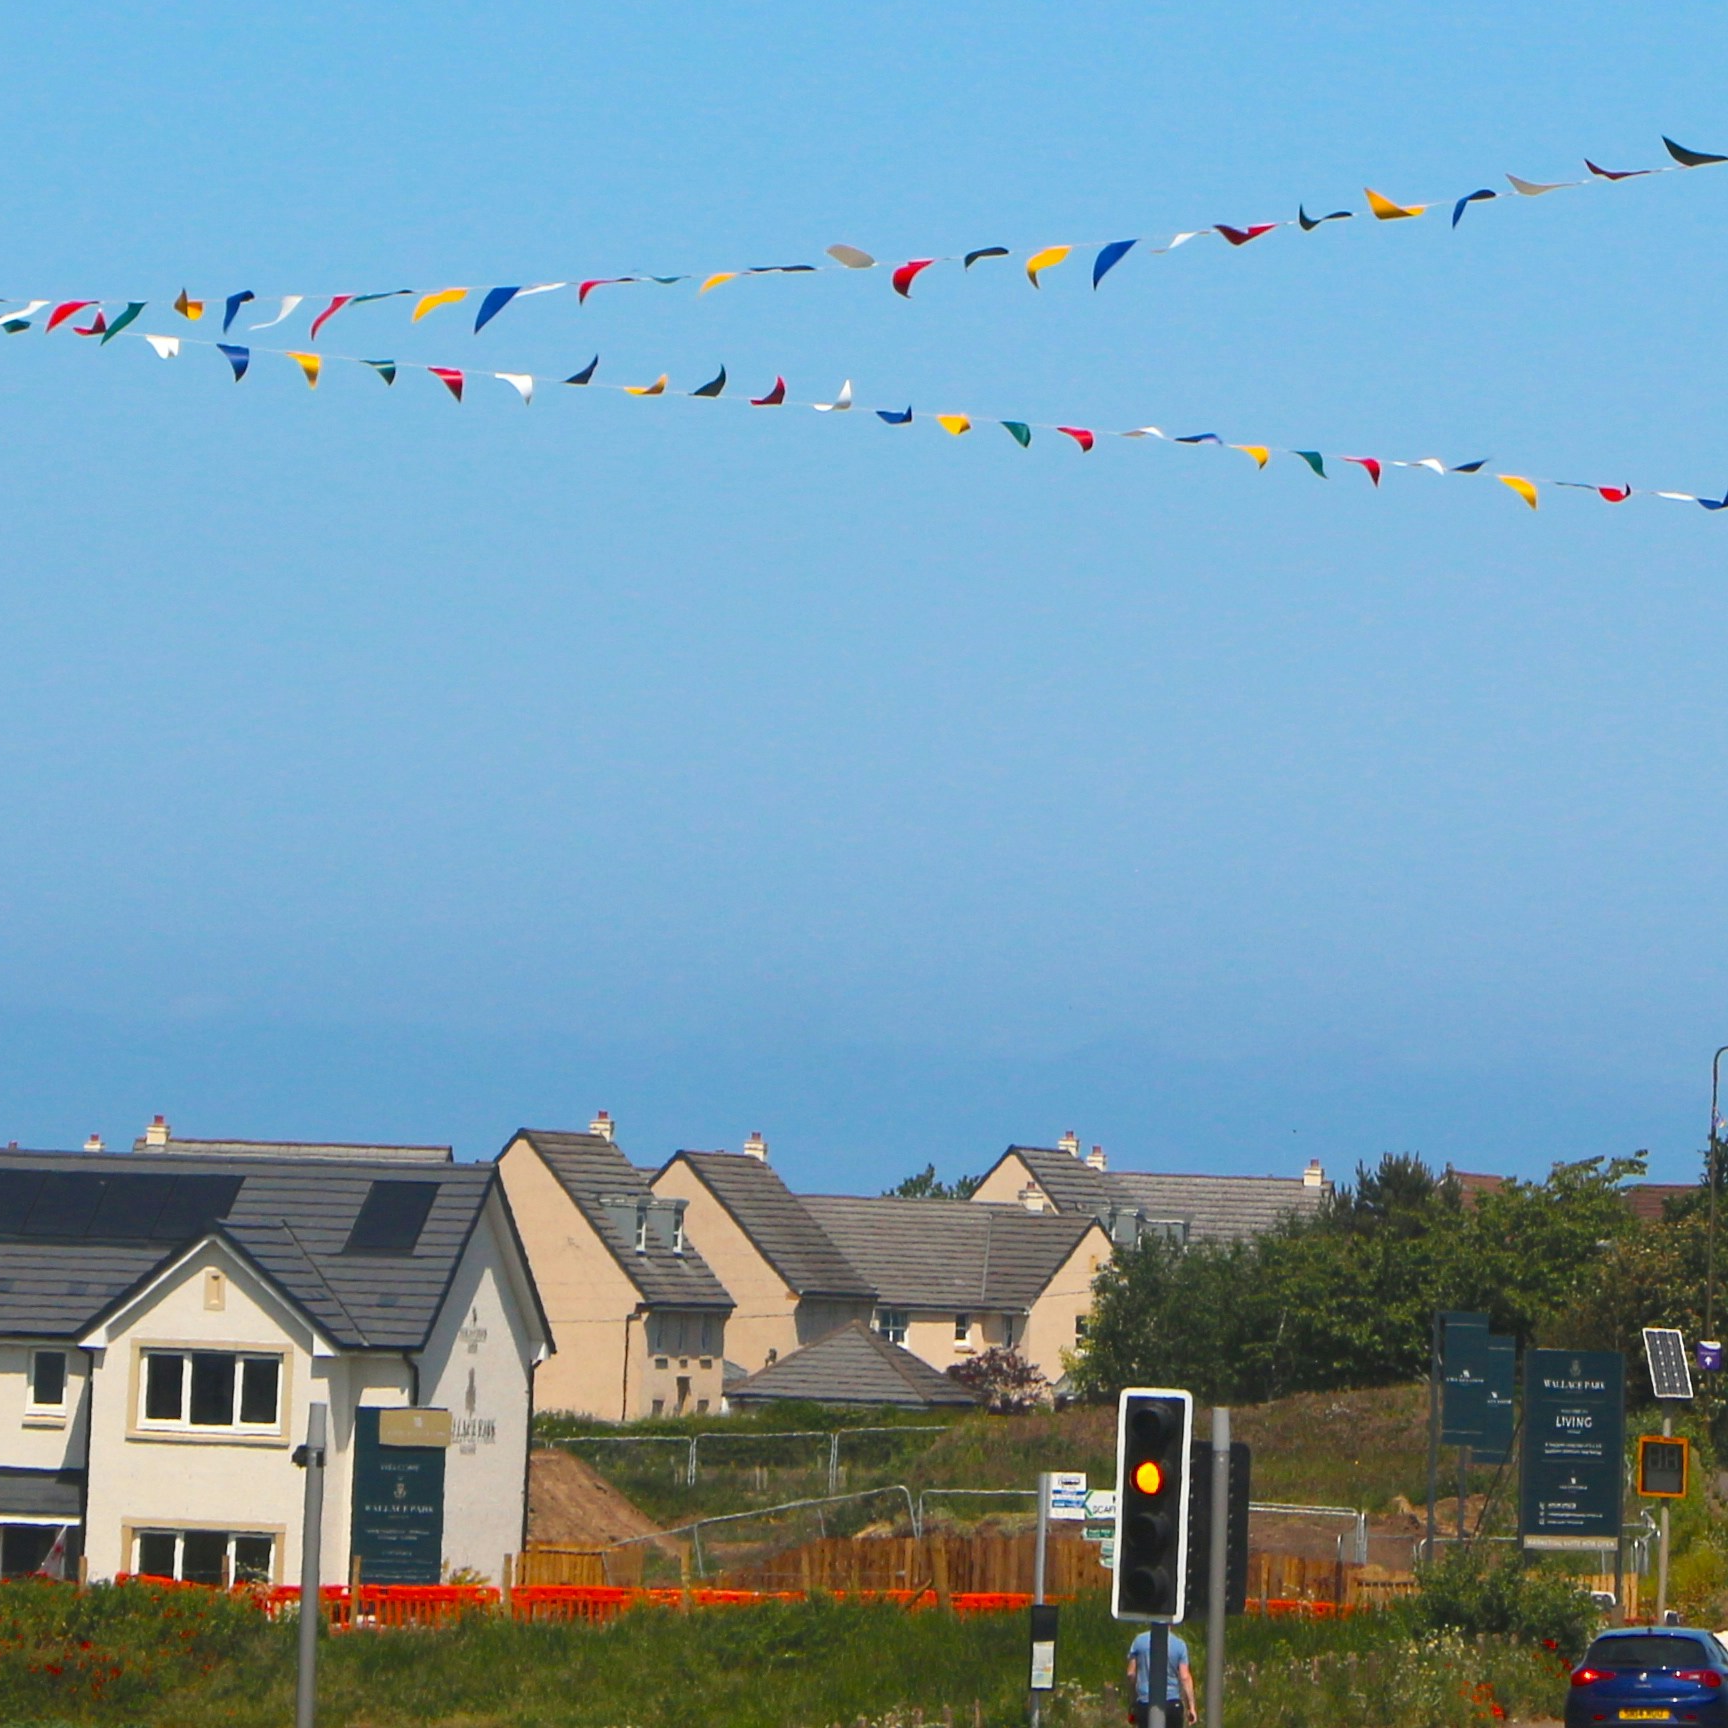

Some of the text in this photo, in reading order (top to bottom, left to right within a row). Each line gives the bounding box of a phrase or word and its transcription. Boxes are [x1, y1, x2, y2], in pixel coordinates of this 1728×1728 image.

[1543, 1378, 1606, 1391] WALLACE PARK
[1555, 1415, 1593, 1429] LIVING
